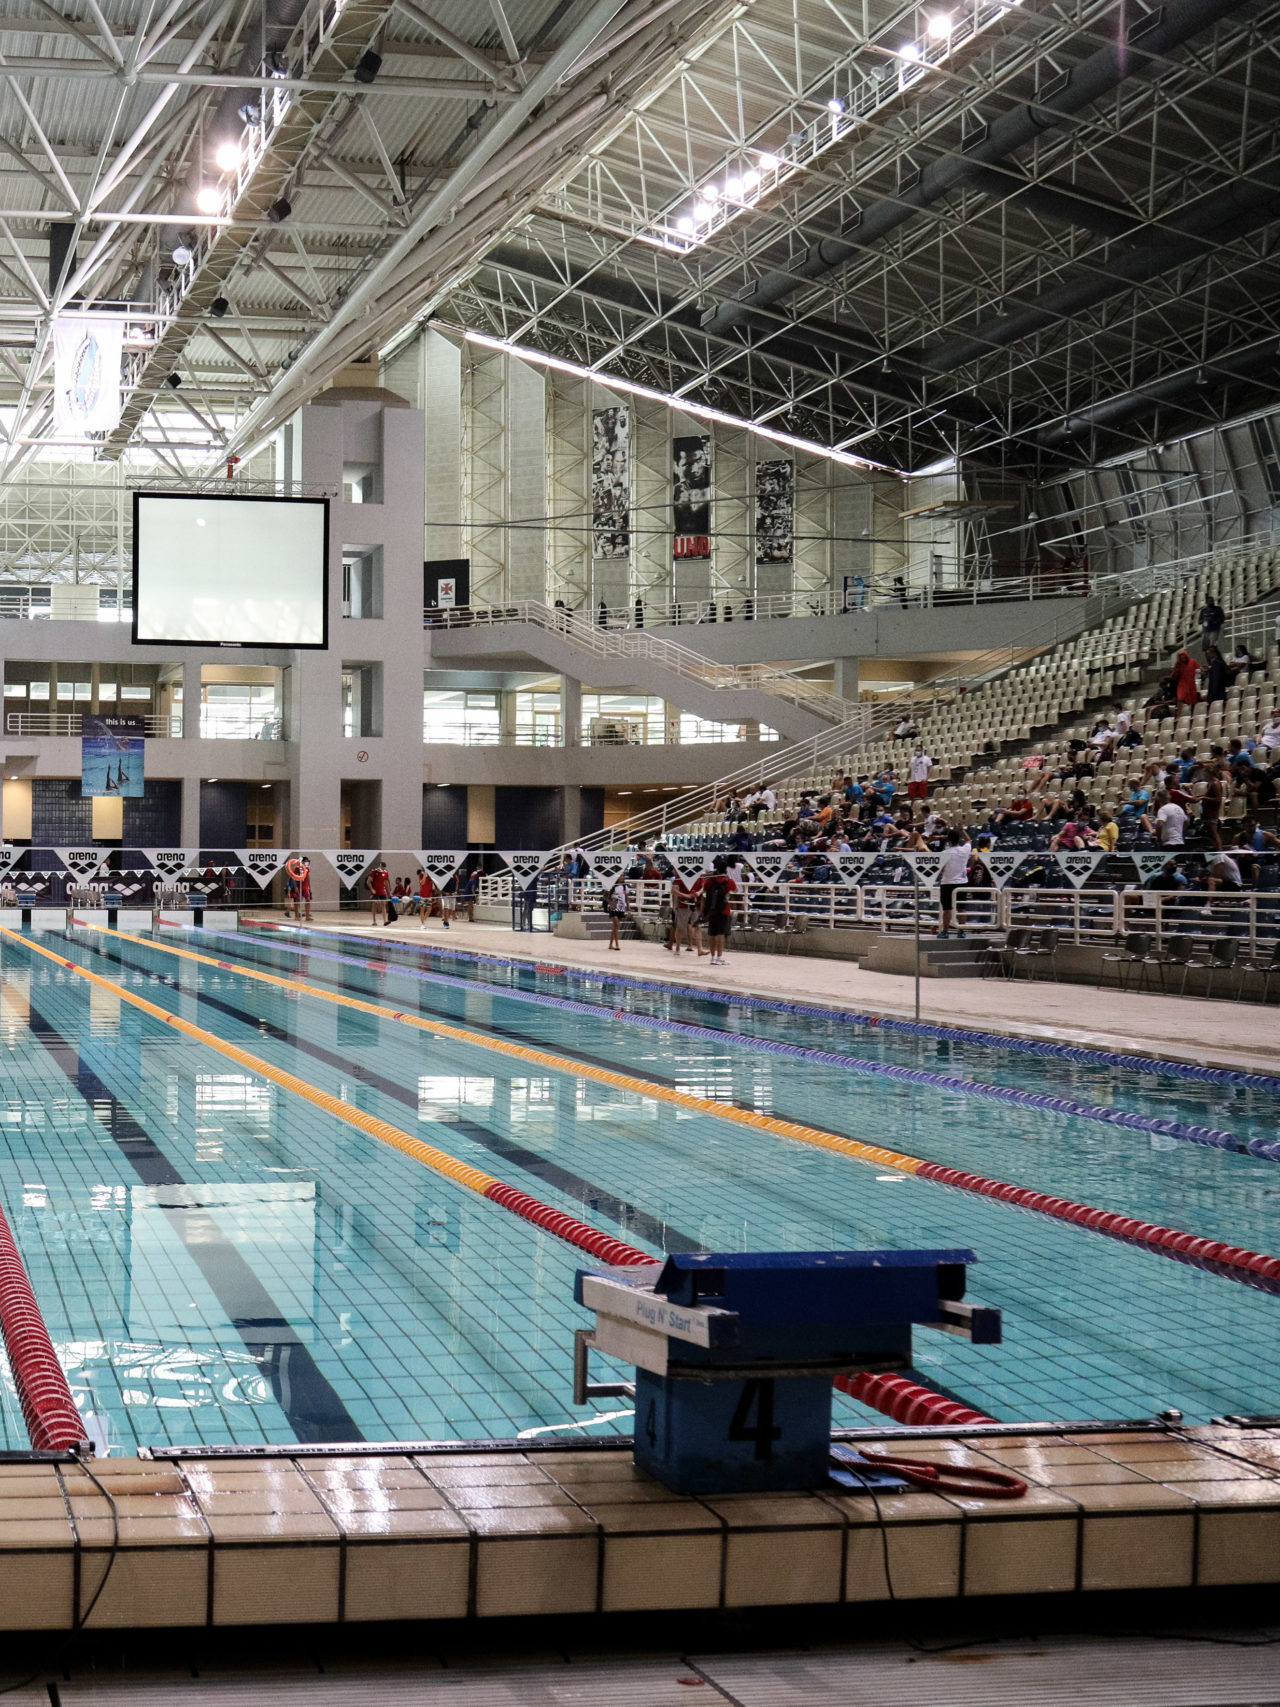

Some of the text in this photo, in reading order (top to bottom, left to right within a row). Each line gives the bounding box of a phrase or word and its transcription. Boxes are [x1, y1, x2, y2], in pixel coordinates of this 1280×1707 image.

[105, 718, 119, 726] this
[120, 718, 126, 726] is
[68, 851, 98, 861] arena
[156, 852, 185, 862] arena
[248, 852, 278, 862] arena
[336, 853, 365, 863] arena
[426, 854, 455, 864] arena
[512, 854, 540, 864] arena
[594, 855, 622, 865] arena
[677, 855, 704, 865] arena
[755, 855, 781, 865] arena
[839, 855, 865, 865] arena
[915, 855, 940, 865] arena
[989, 856, 1015, 865] arena
[1065, 855, 1091, 865] arena
[1141, 855, 1166, 864] arena
[636, 1300, 656, 1325] Plug
[669, 1311, 691, 1333] Start
[728, 1377, 782, 1460] 4
[644, 1399, 657, 1449] 4
